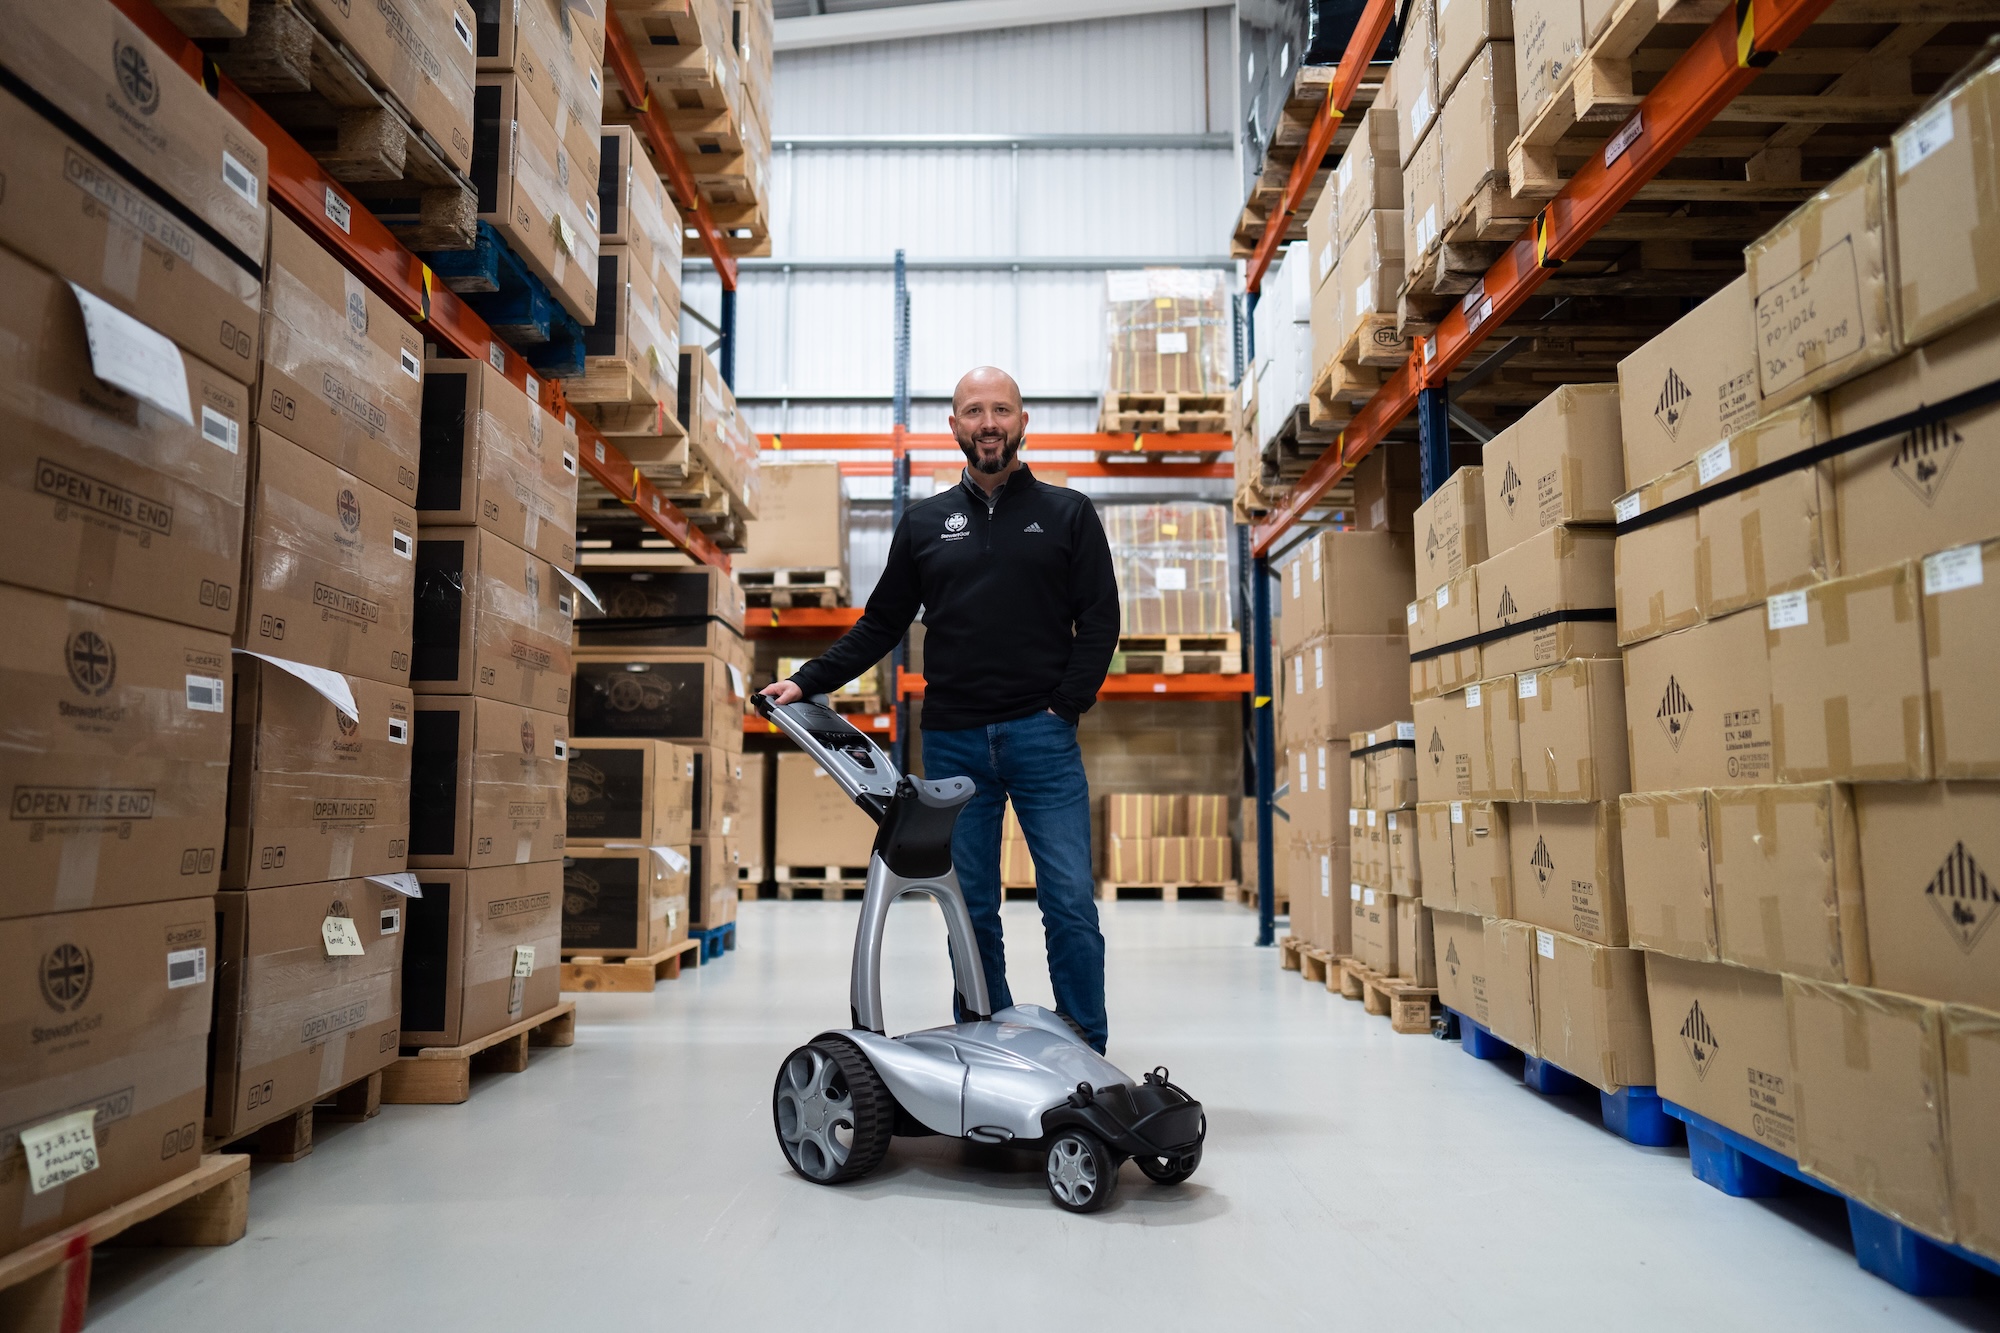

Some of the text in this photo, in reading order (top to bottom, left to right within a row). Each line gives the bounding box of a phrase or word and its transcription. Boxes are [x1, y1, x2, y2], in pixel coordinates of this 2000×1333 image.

[405, 28, 422, 57] THIS
[424, 51, 439, 77] END
[69, 157, 118, 206] OPEN
[123, 191, 156, 234] THIS
[160, 217, 191, 257] END
[324, 379, 384, 427] OPEN THIS END
[40, 468, 169, 529] OPEN THIS END
[315, 587, 377, 619] OPEN THIS END
[513, 642, 526, 657] OPEN
[538, 653, 550, 664] END
[1725, 730, 1752, 742] UN 3480
[16, 792, 151, 814] OPEN THIS END
[315, 802, 374, 816] OPEN THIS END
[510, 805, 524, 816] OPEN
[489, 895, 549, 916] KEEP THIS END CLOSED
[334, 921, 345, 937] Aug
[31, 1014, 103, 1045] StewartGolf
[304, 1004, 366, 1038] OPEN THIS END
